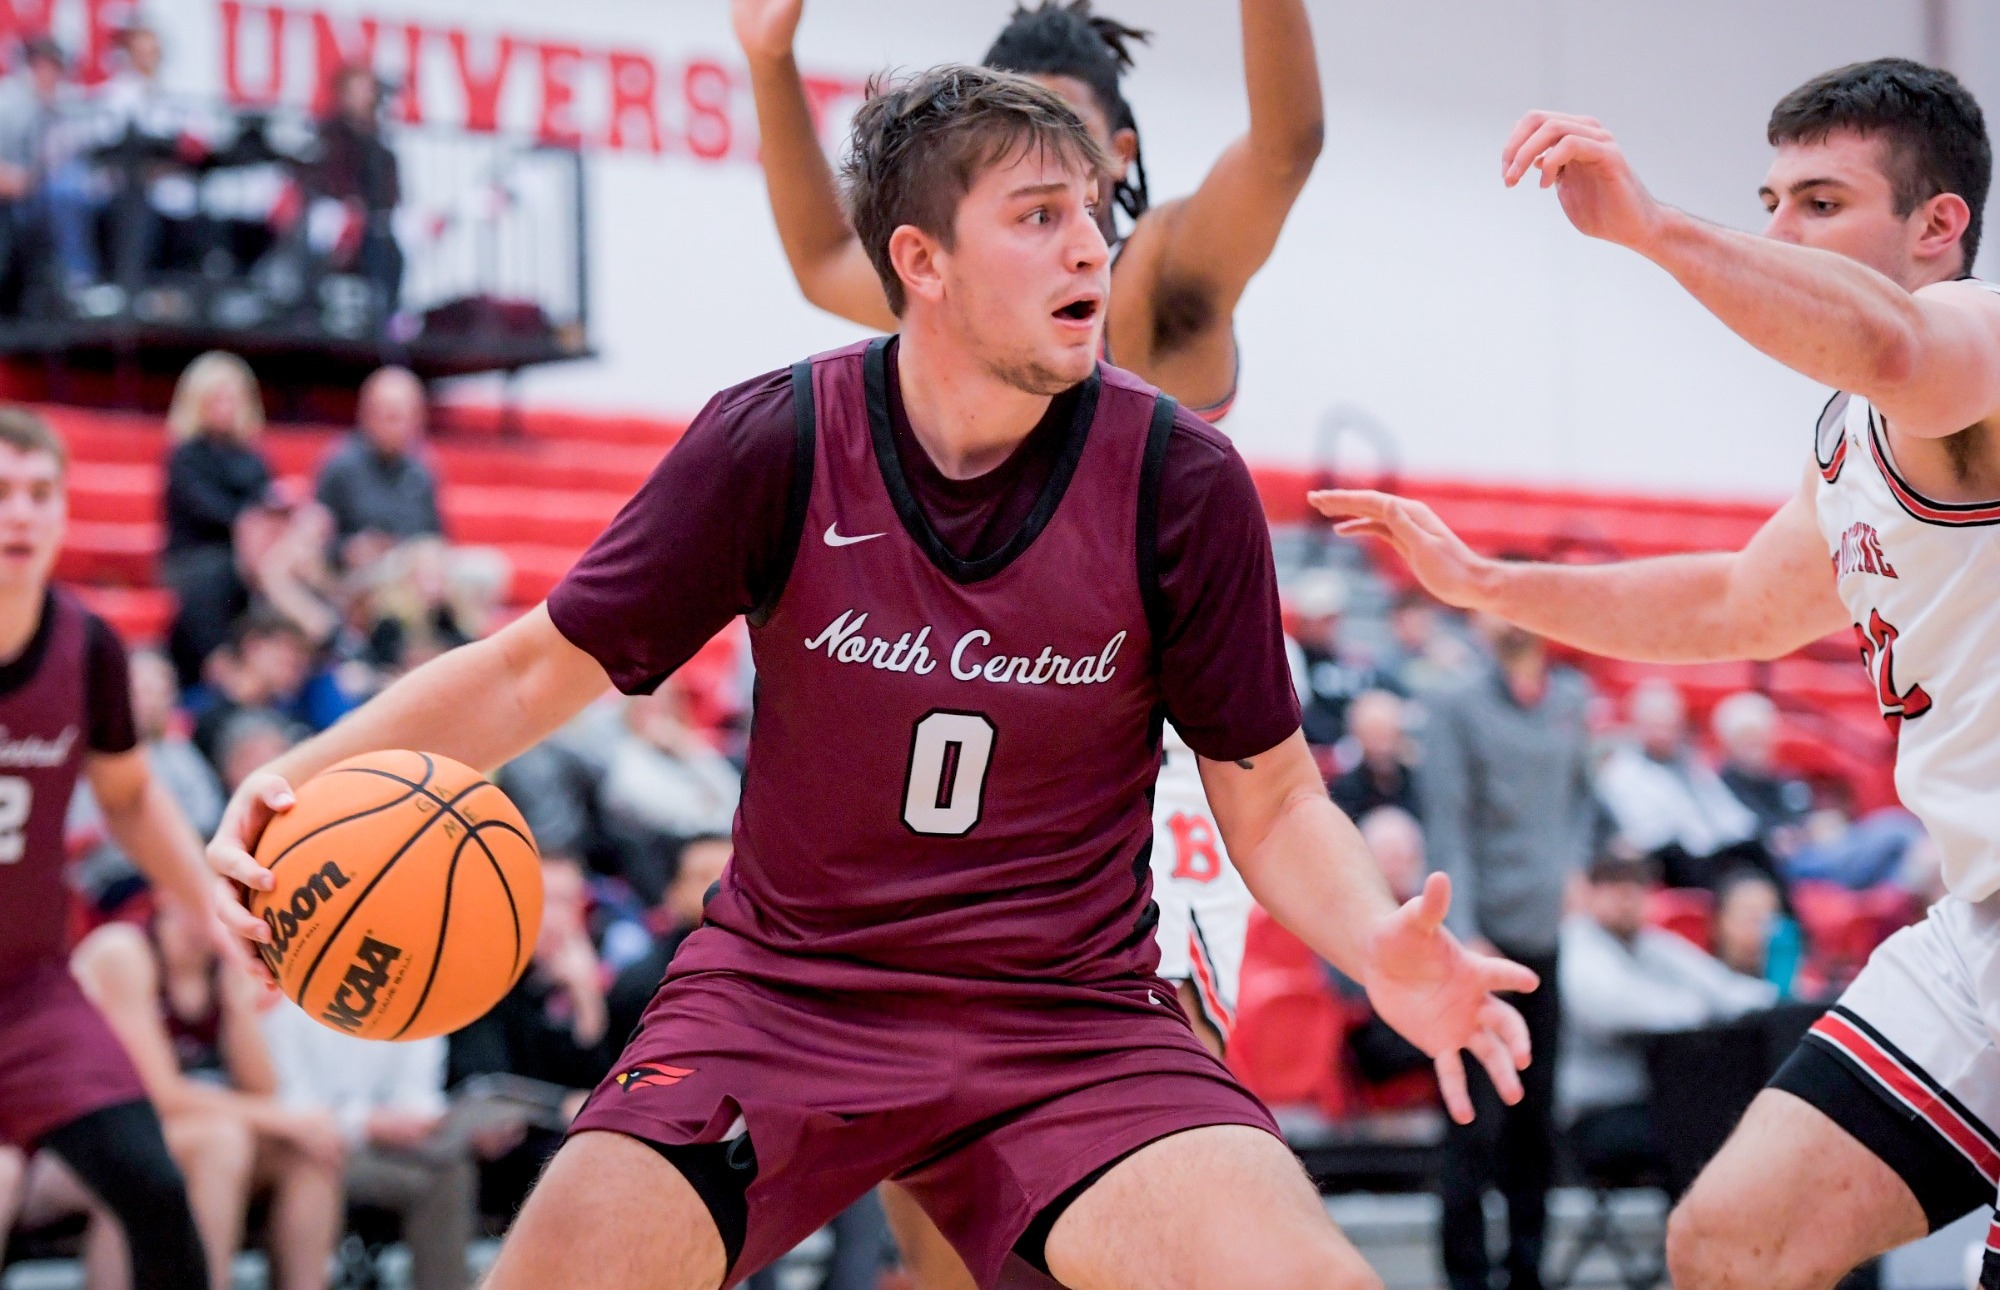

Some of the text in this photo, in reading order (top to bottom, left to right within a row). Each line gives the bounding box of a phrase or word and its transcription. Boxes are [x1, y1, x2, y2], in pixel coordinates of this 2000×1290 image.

[222, 0, 876, 162] UNIVERS
[804, 608, 1127, 685] North Central
[901, 707, 998, 838] 0
[1167, 812, 1220, 883] B
[321, 934, 402, 1033] NCAA
